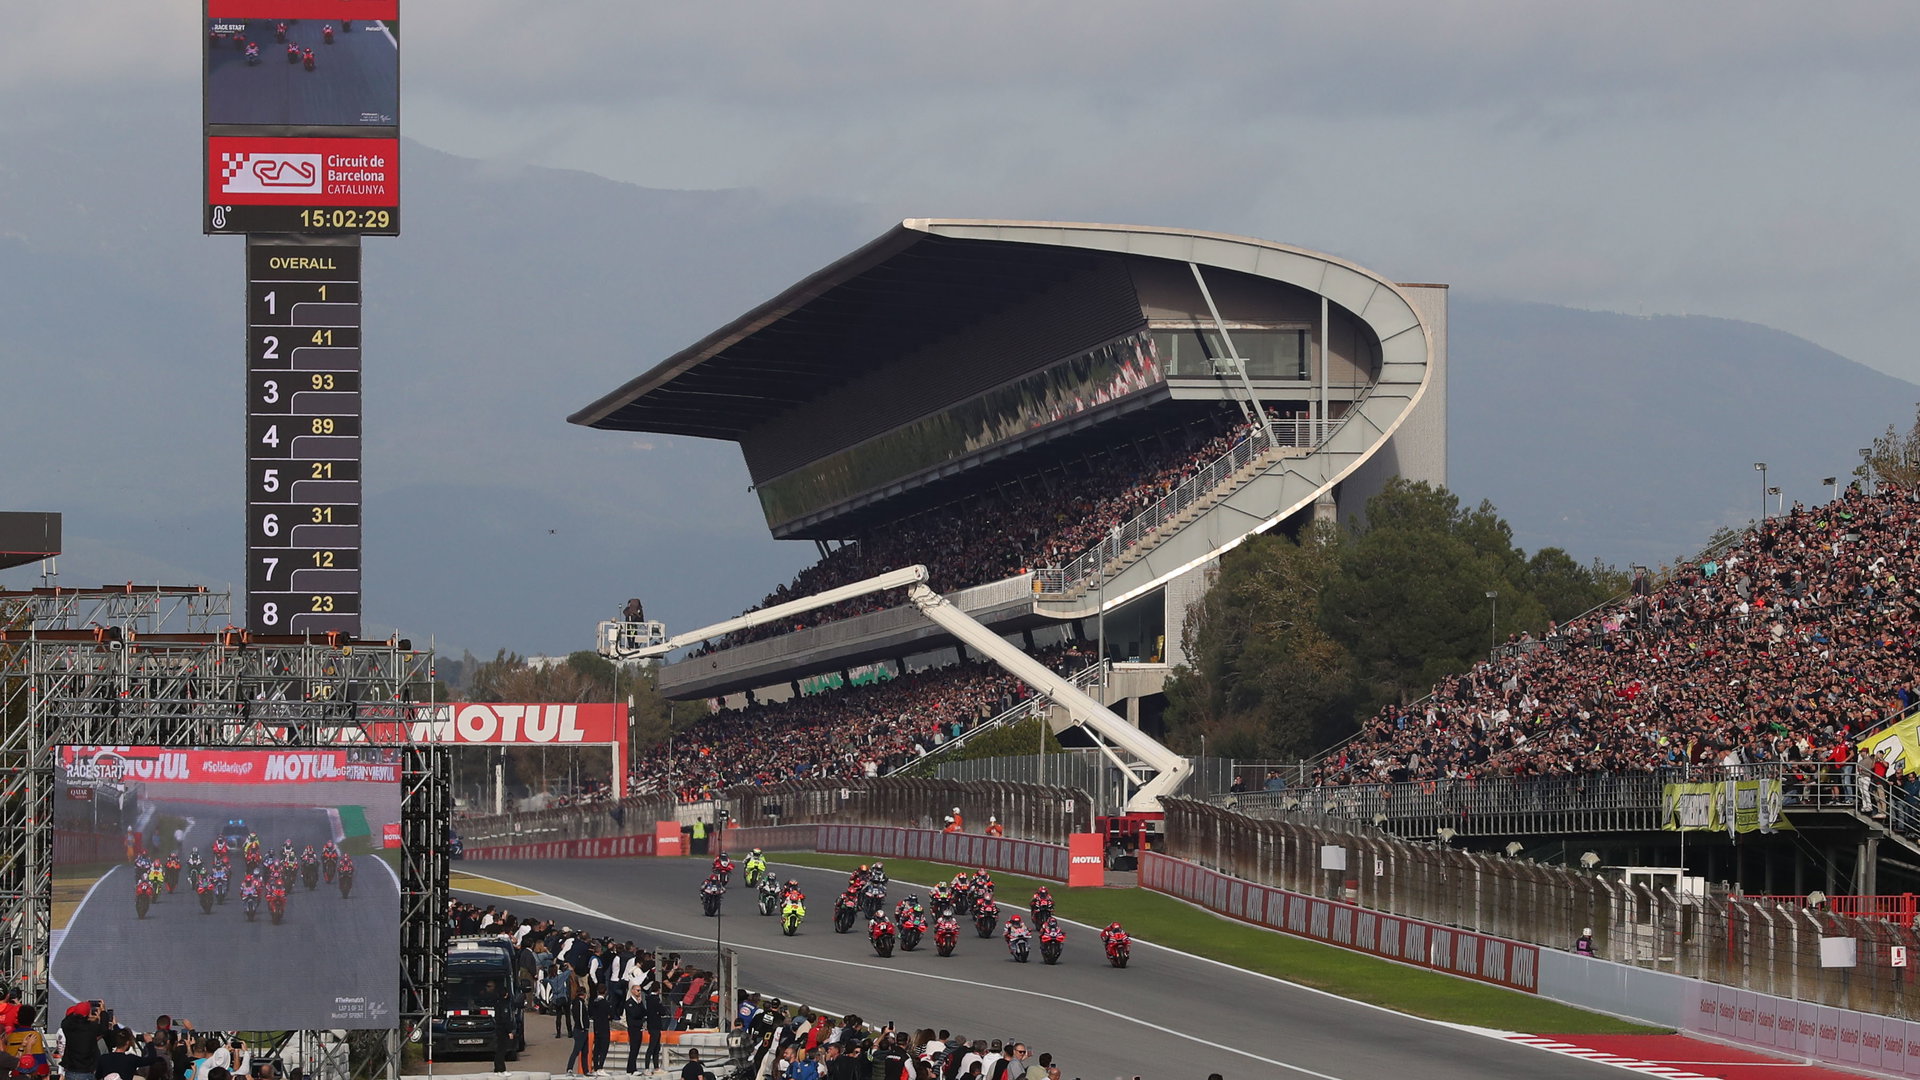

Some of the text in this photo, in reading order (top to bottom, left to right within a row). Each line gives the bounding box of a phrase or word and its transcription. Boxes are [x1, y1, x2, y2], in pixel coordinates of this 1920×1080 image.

[327, 155, 385, 167] Circuit de
[327, 169, 385, 181] Barcelona
[327, 185, 385, 195] CATALUNYA
[300, 210, 389, 228] 15:02:29
[269, 257, 337, 270] OVERALL
[264, 285, 326, 315] 1 1
[262, 329, 332, 359] 2 41
[263, 374, 334, 404] 3 93
[262, 418, 334, 448] 4 89
[263, 462, 332, 492] 5 21
[263, 507, 332, 537] 6 31
[262, 551, 334, 581] 7 12
[262, 596, 334, 626] 8 23
[410, 704, 585, 742] MOTUL
[66, 764, 123, 779] RACE START
[265, 754, 337, 781] MOTUL
[1072, 856, 1101, 864] MOTUL
[1511, 945, 1535, 988] MOTUL
